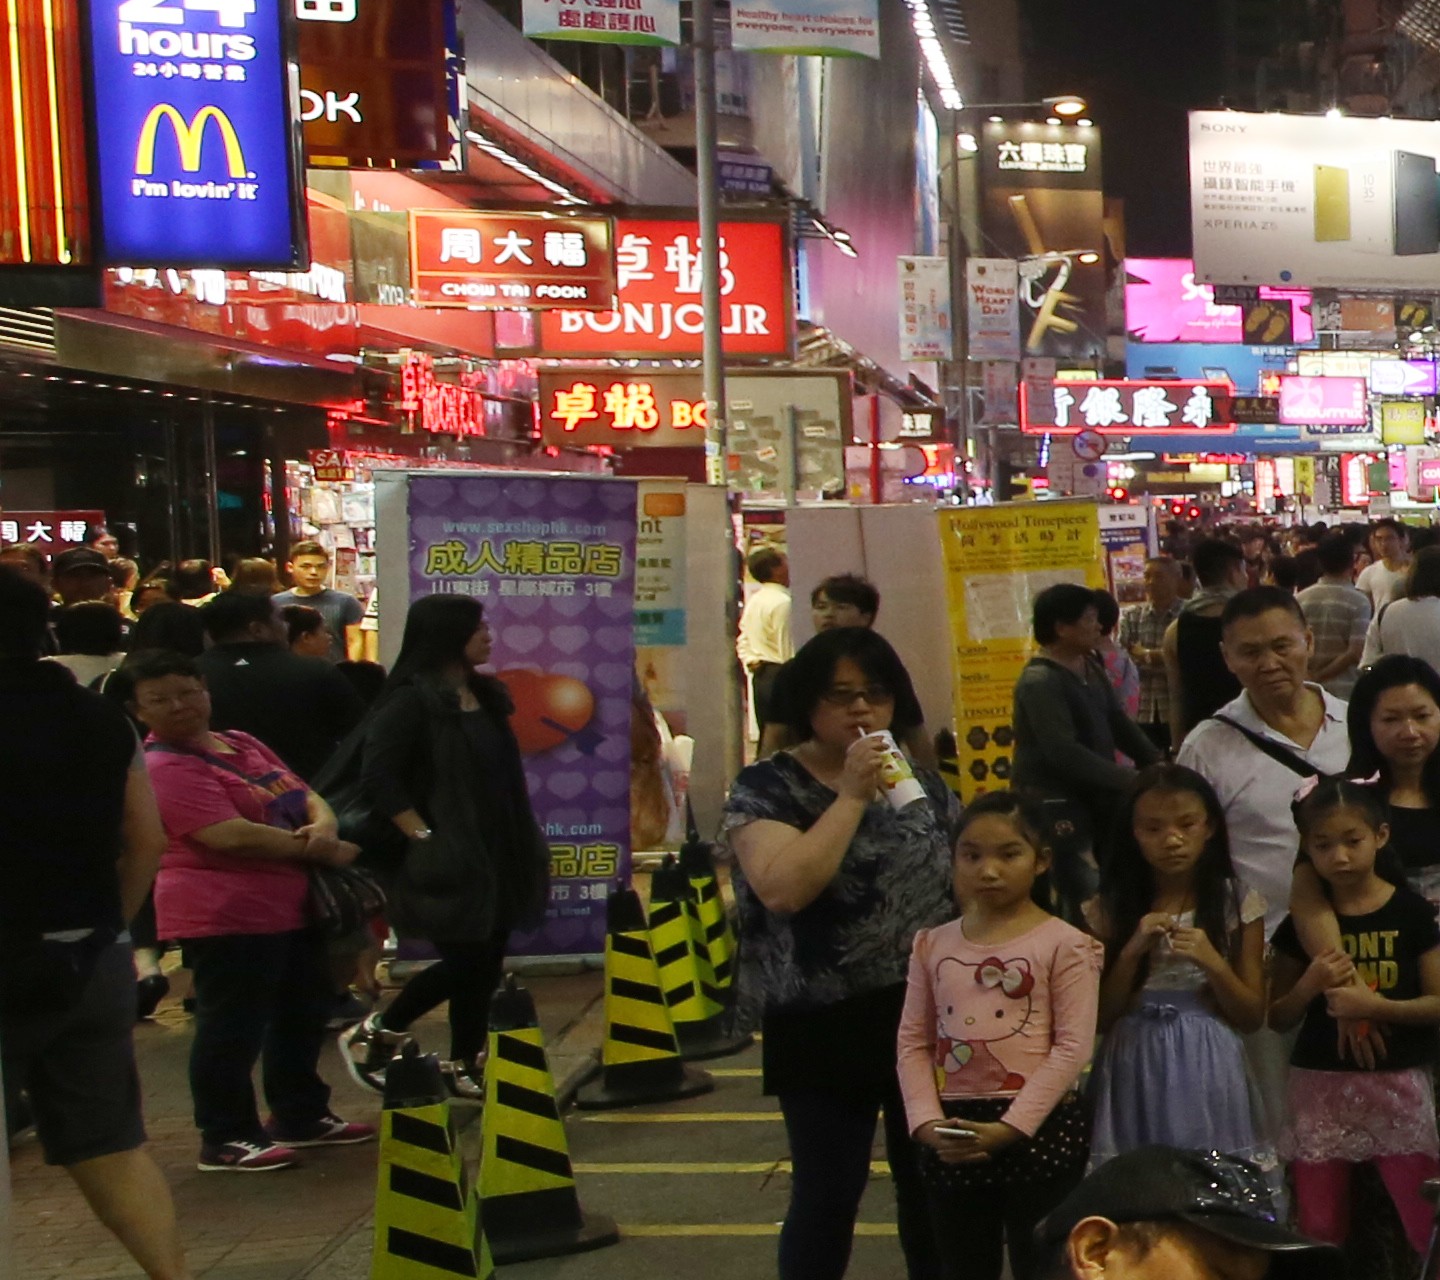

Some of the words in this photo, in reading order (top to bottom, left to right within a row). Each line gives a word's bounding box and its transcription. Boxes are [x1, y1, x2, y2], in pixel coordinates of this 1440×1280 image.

[118, 21, 257, 60] hours
[1200, 124, 1248, 133] SONY
[440, 227, 588, 268] 周大福
[441, 282, 497, 298] CHOW
[501, 283, 531, 299] TAI
[536, 284, 588, 300] FOOK
[425, 540, 622, 576] 成人精品店
